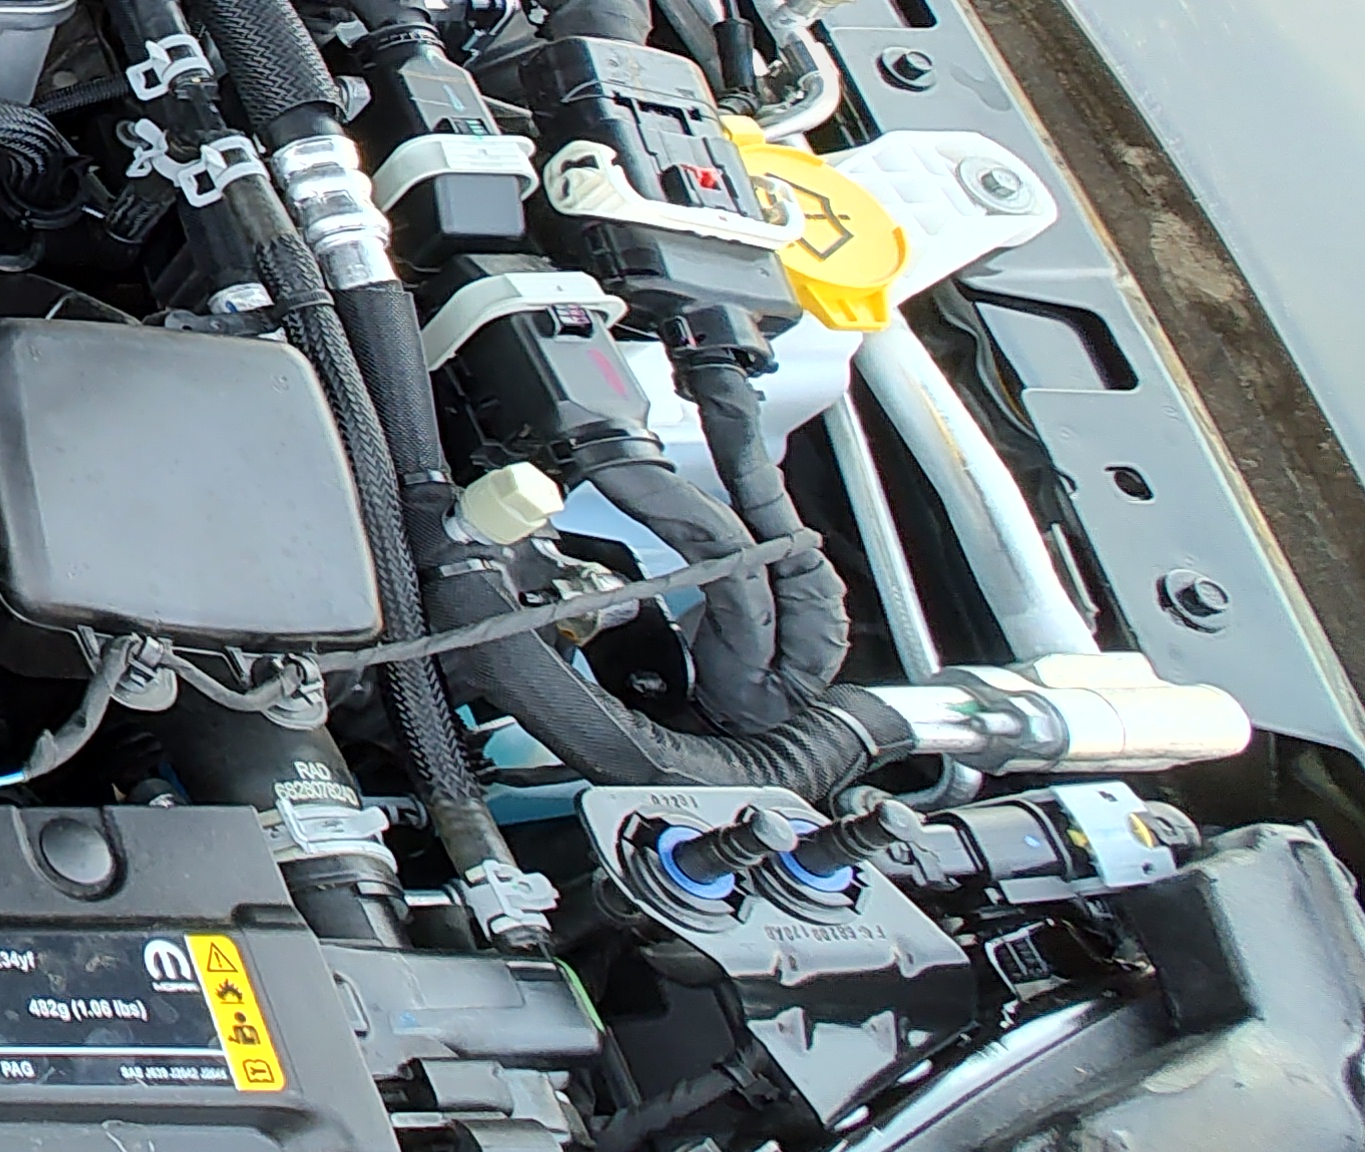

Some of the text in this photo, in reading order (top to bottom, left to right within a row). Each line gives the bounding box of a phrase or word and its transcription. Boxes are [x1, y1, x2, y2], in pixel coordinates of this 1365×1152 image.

[294, 761, 331, 779] RAD
[29, 999, 149, 1022] 482g (1.06 lbs)
[0, 1060, 36, 1079] PAG
